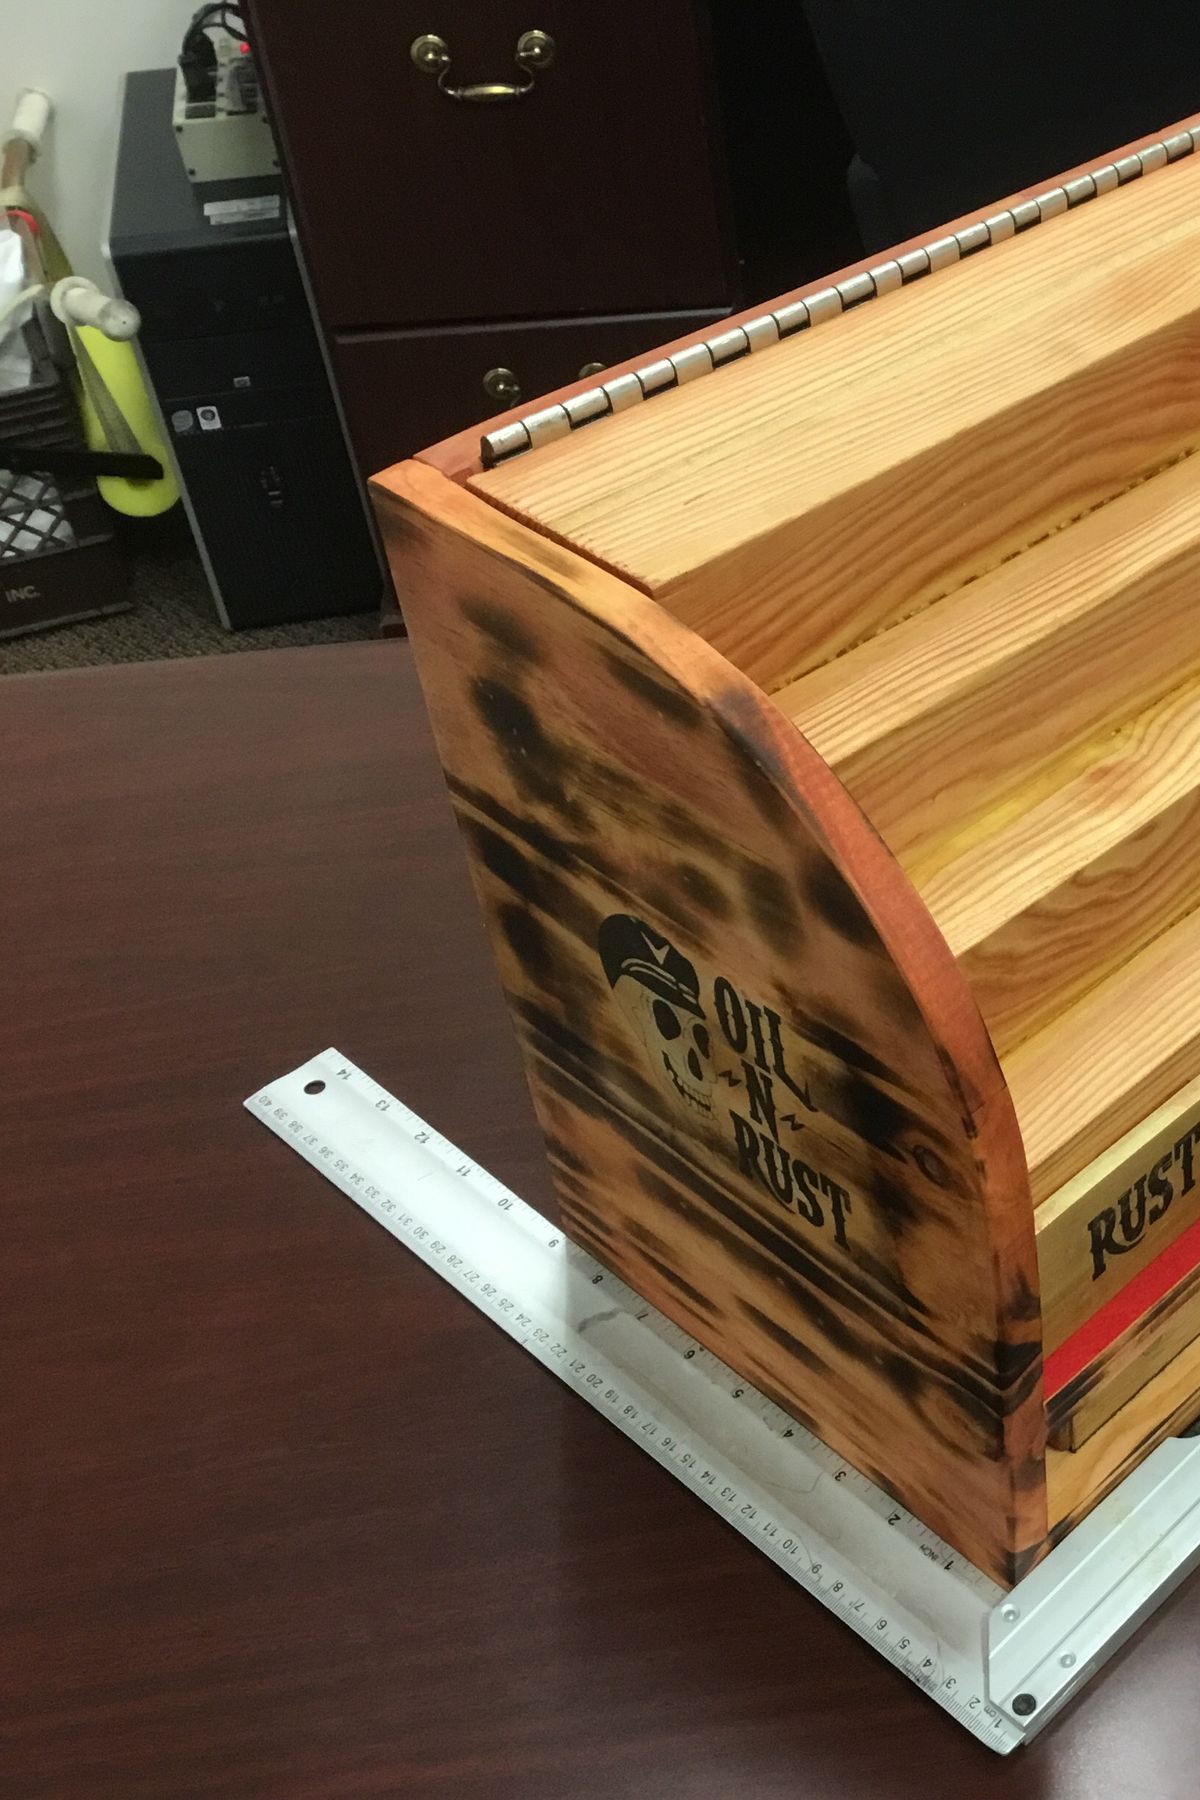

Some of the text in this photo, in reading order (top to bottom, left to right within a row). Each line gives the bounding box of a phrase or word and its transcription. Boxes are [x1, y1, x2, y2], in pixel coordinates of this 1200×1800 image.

[5, 585, 40, 602] INC.
[714, 976, 818, 1112] OIL
[729, 1109, 852, 1250] RUST
[336, 1068, 955, 1571] 1 INCH 2 3 4 5 6 7 8 9 10 11 12 13 14
[258, 1095, 1003, 1729] 1 cm 2 3 4 5 6 7 8 9 10 11 12 13 14 15 16 17 18 19 20 21 22 23 24 25 26 27 28 29 30 31 32 33 34 35 36 37 38 39 40
